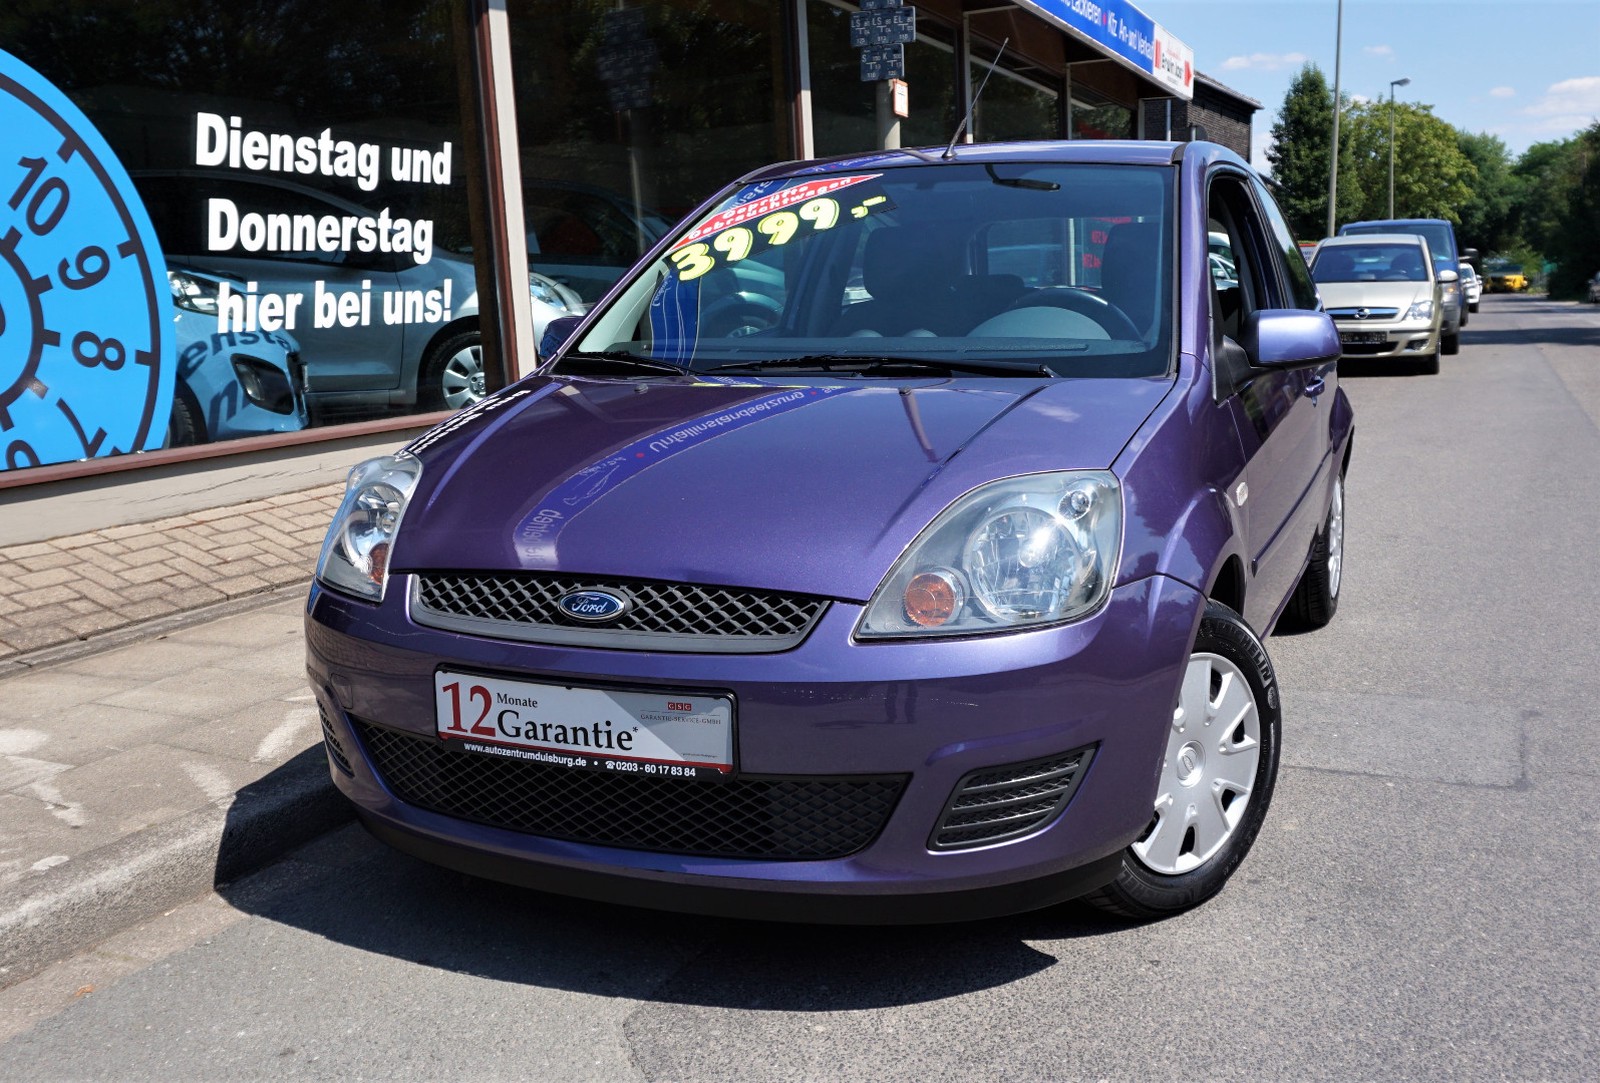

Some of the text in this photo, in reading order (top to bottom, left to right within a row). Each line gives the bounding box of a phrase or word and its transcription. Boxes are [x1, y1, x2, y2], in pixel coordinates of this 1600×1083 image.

[196, 112, 452, 192] Dienstag und
[8, 156, 70, 236] 10
[207, 198, 434, 265] Donnerstag
[217, 278, 453, 334] hier bei uns!
[72, 331, 126, 371] 8
[571, 596, 608, 613] Ford
[442, 681, 496, 738] 12
[496, 692, 538, 709] Monate
[668, 702, 692, 711] GSG
[463, 741, 587, 768] www.autozentrumduisburg.de
[616, 761, 639, 773] 0203
